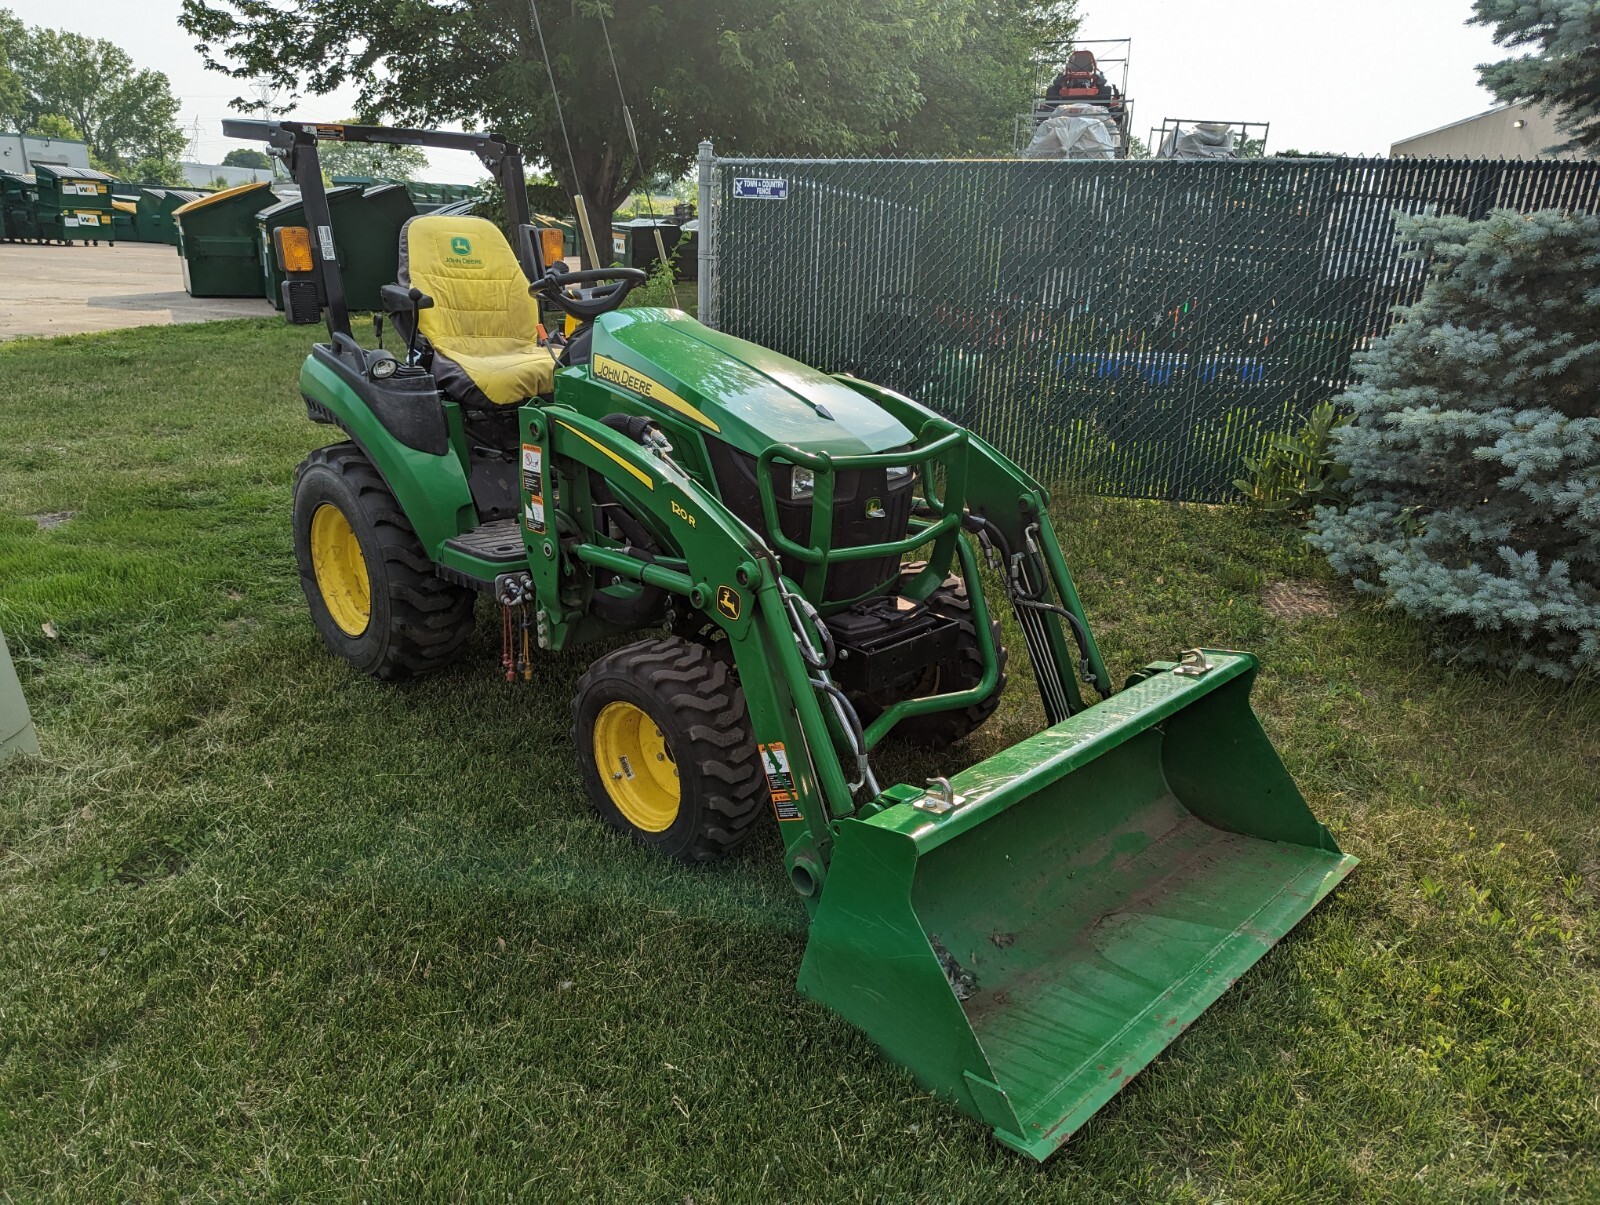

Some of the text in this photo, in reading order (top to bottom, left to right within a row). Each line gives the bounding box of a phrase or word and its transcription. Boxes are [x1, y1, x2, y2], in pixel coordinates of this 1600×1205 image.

[744, 180, 758, 188] TOWN
[762, 180, 785, 189] COUNTRY
[757, 187, 772, 195] FENCE
[445, 256, 482, 265] JOHN DEERE
[597, 361, 653, 396] JOHN DEERE
